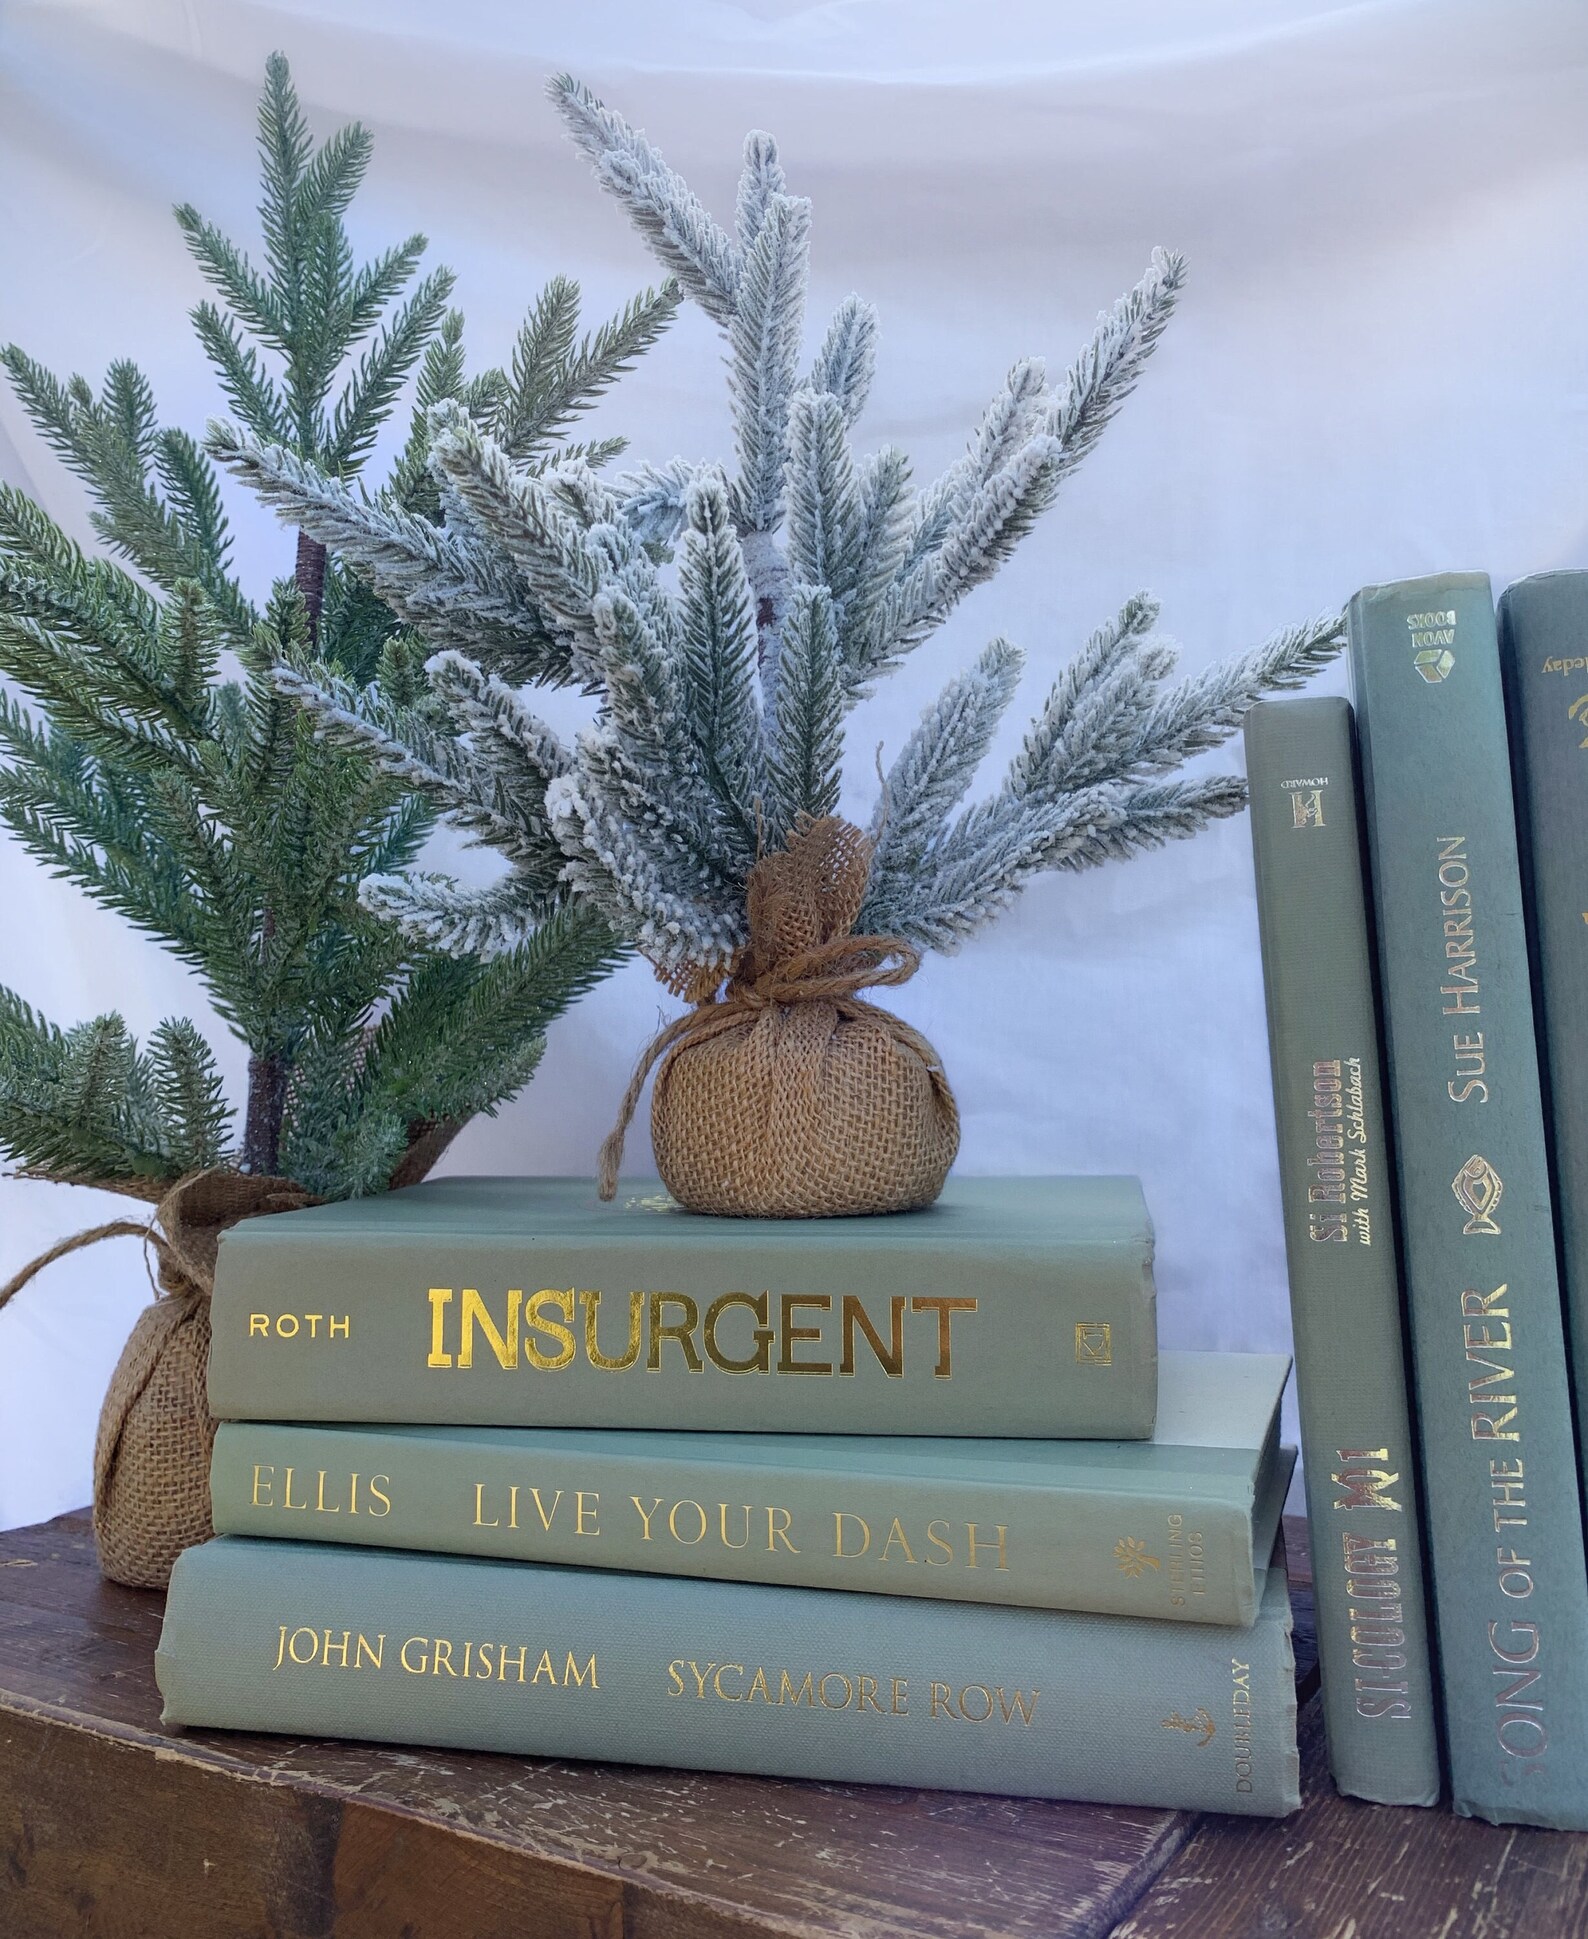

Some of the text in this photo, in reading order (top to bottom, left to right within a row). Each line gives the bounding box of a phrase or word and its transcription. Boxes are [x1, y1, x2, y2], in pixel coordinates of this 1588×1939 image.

[1406, 610, 1457, 630] BOOKS
[1411, 629, 1455, 648] AVON
[1280, 776, 1329, 790] HOWARD
[1436, 835, 1489, 1104] SUE HARRISON
[1306, 1059, 1348, 1242] Si Robertson
[1343, 1056, 1372, 1247] with Mark Schlabach
[248, 1287, 978, 1380] ROTH INSURGENT
[251, 1464, 1011, 1572] ELLIS LIVE YOUR DASH
[1166, 1513, 1186, 1607] STERLING
[1460, 1283, 1548, 1787] SONG OF THE RIVER
[272, 1625, 1041, 1728] JOHN GRISHAM SYCAMORE ROW
[1231, 1657, 1254, 1794] DOUBLEDAY
